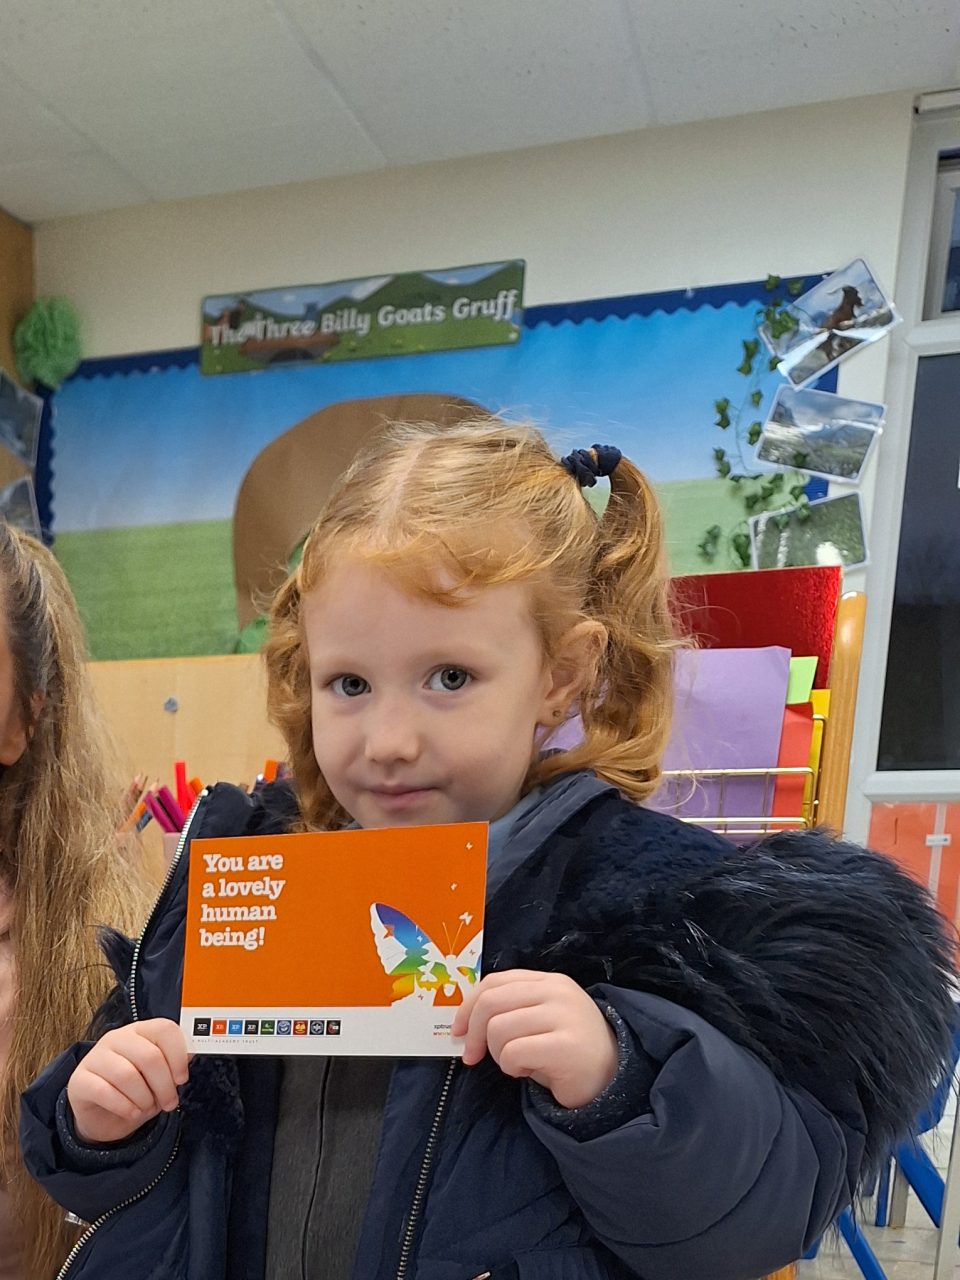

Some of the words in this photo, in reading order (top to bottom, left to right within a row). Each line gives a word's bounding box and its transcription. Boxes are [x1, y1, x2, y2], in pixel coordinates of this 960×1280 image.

[252, 312, 316, 340] Three
[321, 309, 371, 336] Billy
[377, 302, 445, 328] Goats
[453, 289, 518, 320] Gruff
[203, 853, 244, 873] You
[248, 853, 284, 871] are
[202, 880, 215, 898] a
[218, 876, 286, 901] lovely
[200, 903, 277, 923] human
[199, 927, 266, 951] being!
